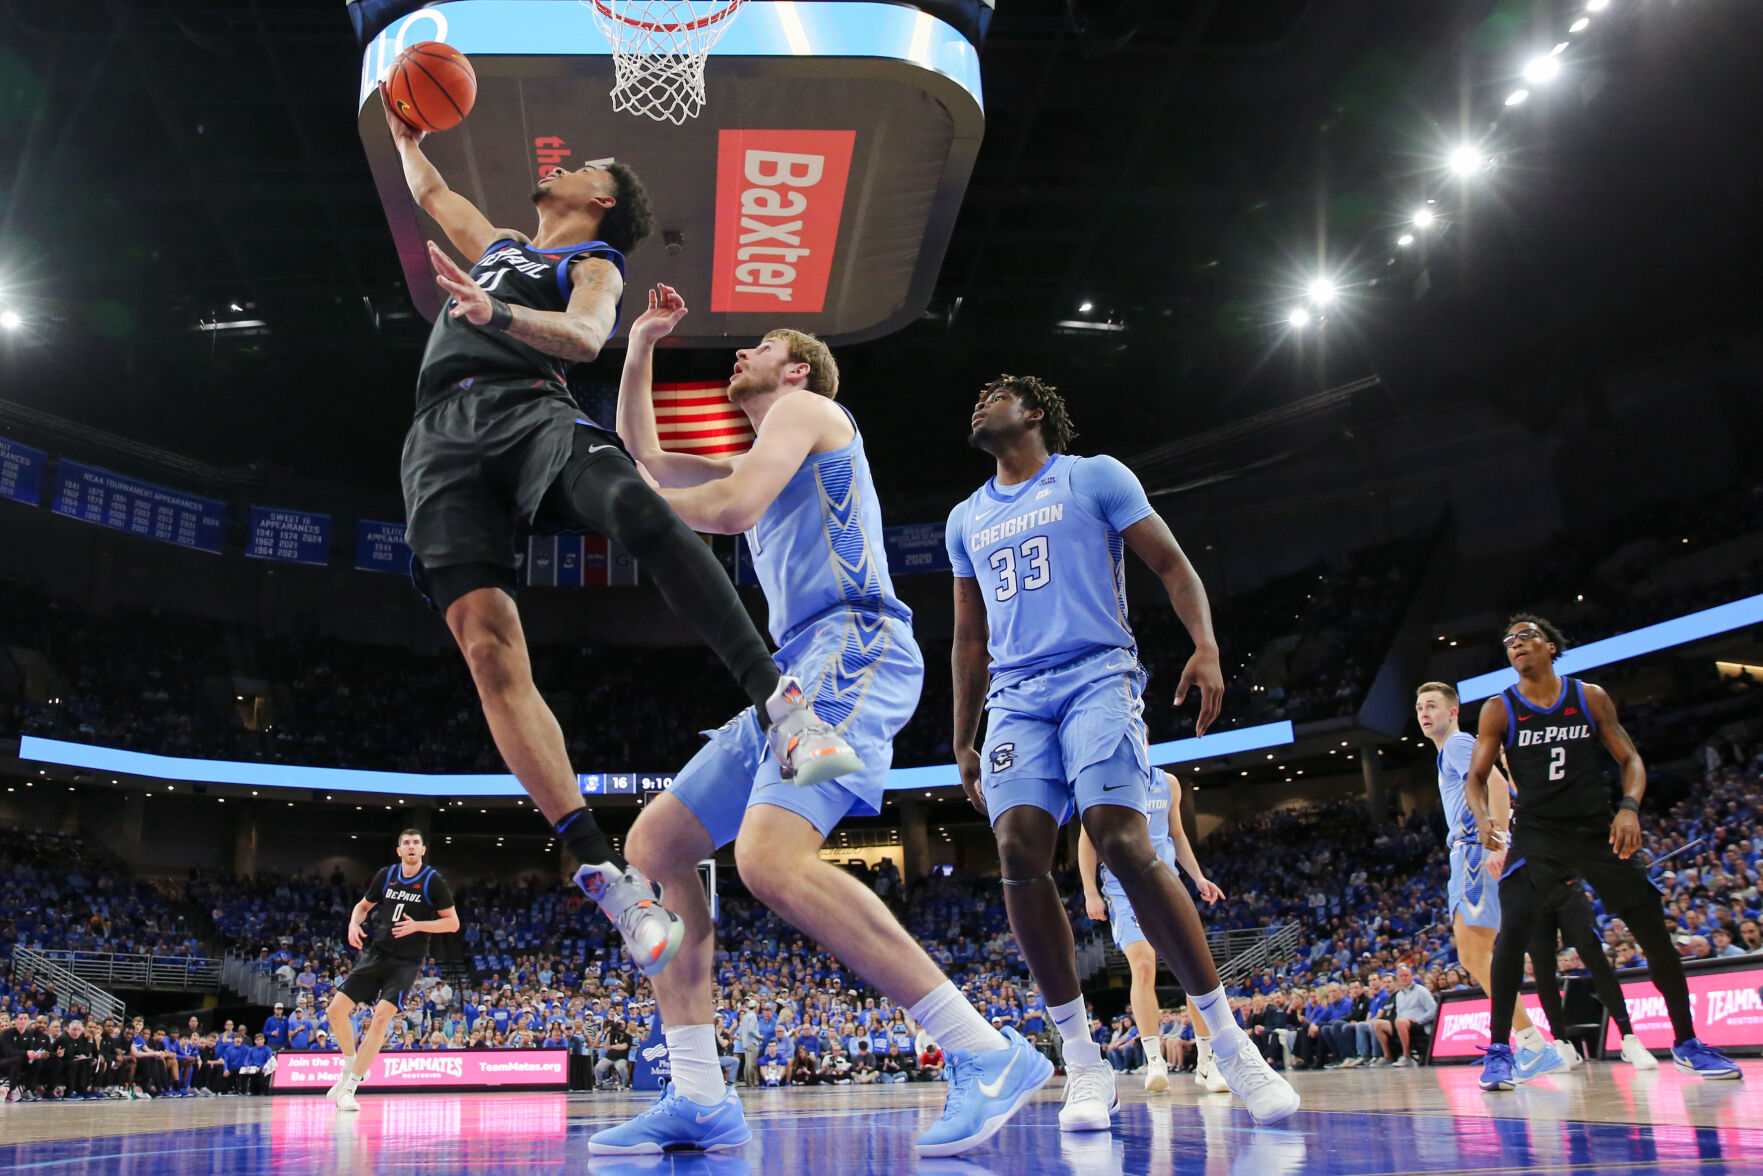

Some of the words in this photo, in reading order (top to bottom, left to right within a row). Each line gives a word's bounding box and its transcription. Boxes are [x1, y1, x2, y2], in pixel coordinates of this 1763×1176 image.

[735, 149, 825, 301] Baxter
[84, 472, 104, 485] NCAA
[106, 479, 153, 498] TOURNAMENT
[154, 492, 203, 512] APPEARANCES
[270, 512, 299, 524] SWEET
[302, 516, 312, 525] 16
[259, 519, 321, 534] APPEARANCES
[381, 527, 403, 537] ELITE
[971, 503, 1064, 552] CREIGHTON
[256, 528, 274, 537] 1941
[280, 531, 298, 541] 1974
[302, 534, 322, 544] 2024
[255, 537, 274, 547] 1962
[279, 540, 297, 549] 2021
[375, 543, 391, 552] 1941
[254, 546, 273, 555] 1964
[277, 548, 298, 559] 2023
[372, 551, 393, 560] 2023
[904, 552, 933, 566] 2020
[989, 535, 1051, 602] 33
[1549, 746, 1566, 781] 2
[612, 776, 628, 789] 16
[642, 777, 673, 789] 9:10
[391, 903, 405, 922] 0
[288, 1057, 310, 1067] Join
[311, 1057, 330, 1066] the
[384, 1057, 463, 1078] TEAMMATES
[479, 1061, 562, 1073] TeamMates.org
[291, 1071, 305, 1081] Be
[308, 1073, 315, 1081] a
